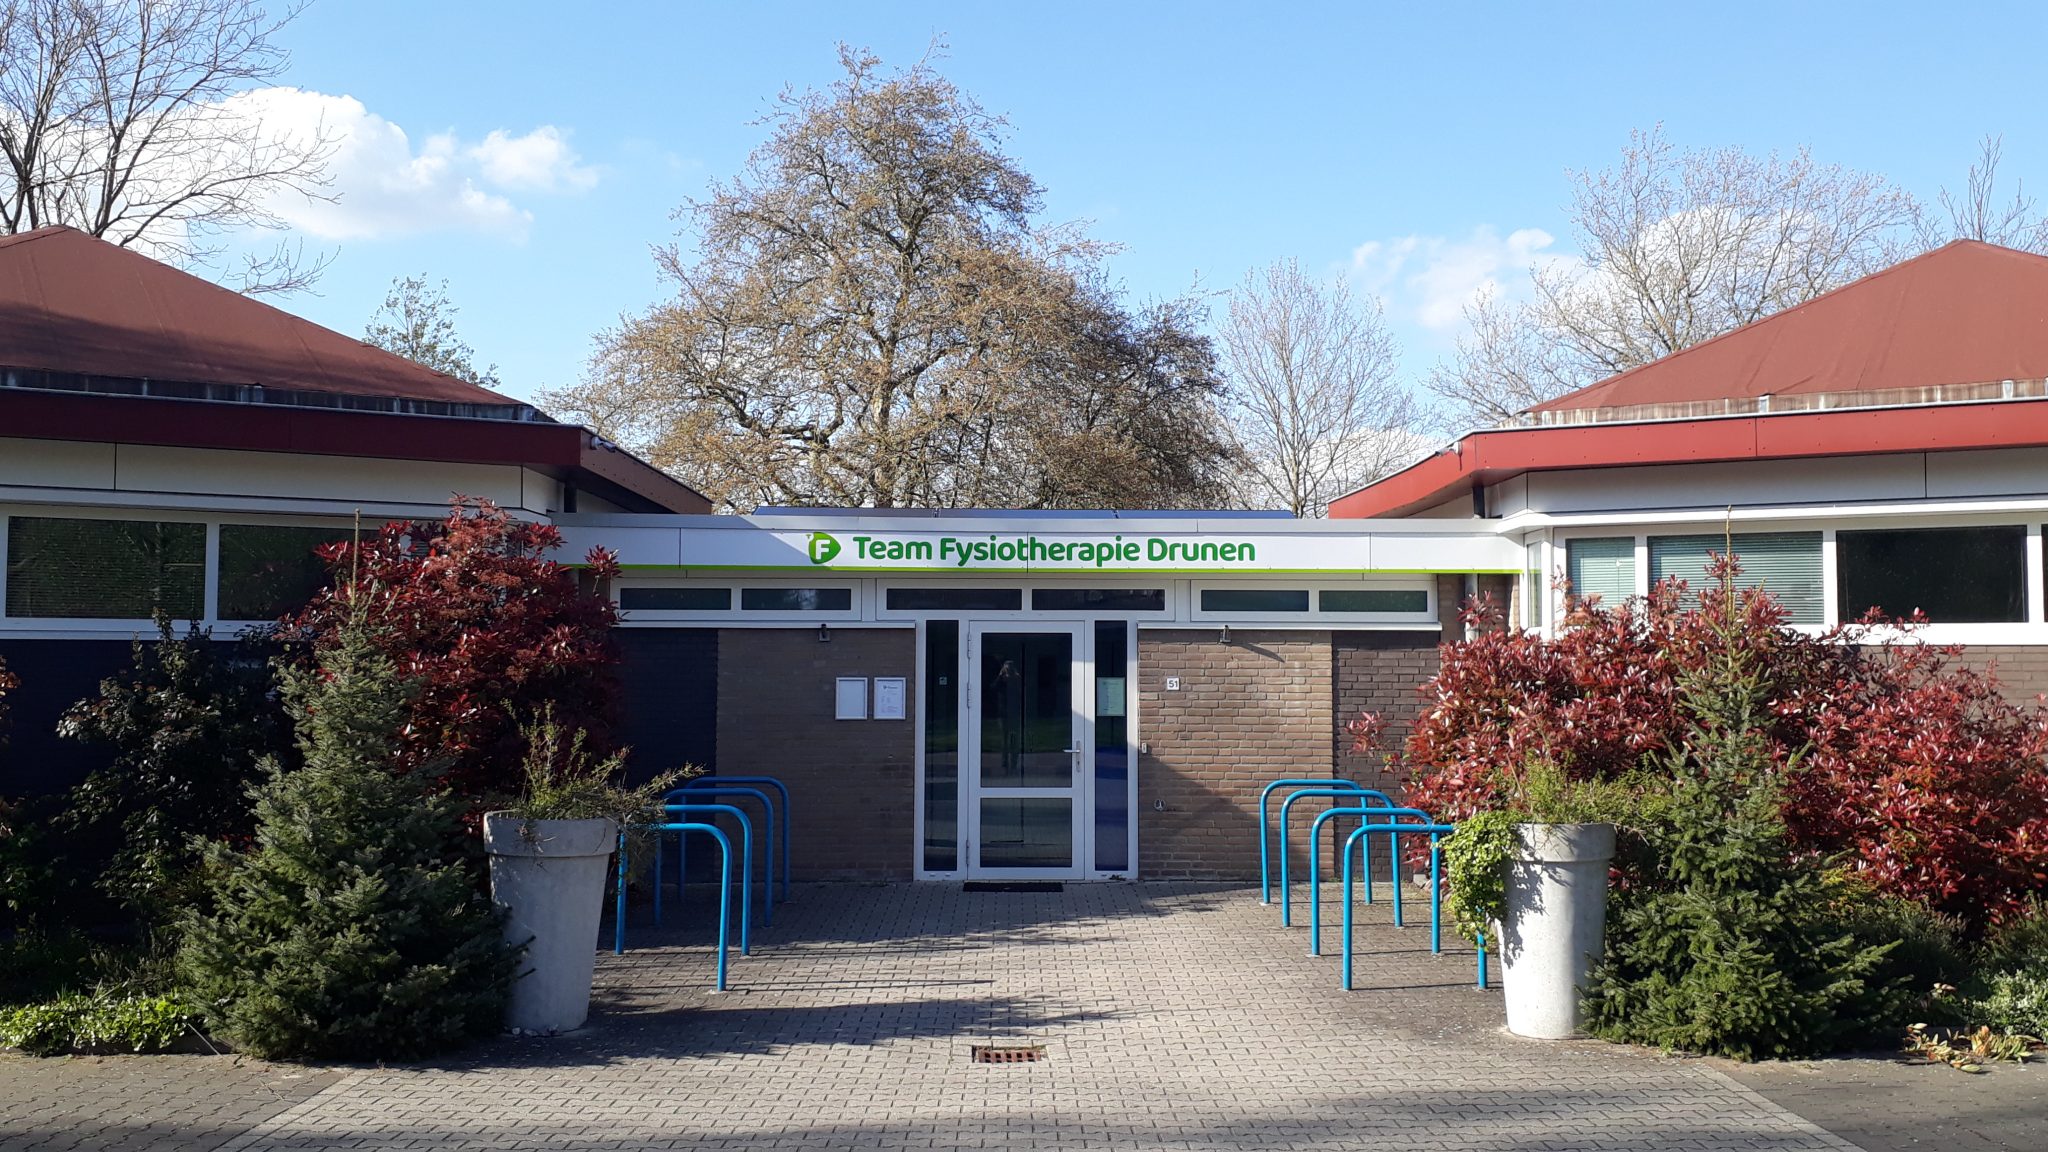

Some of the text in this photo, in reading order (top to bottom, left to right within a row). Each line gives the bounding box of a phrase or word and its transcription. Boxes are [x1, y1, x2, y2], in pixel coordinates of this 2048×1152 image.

[815, 539, 831, 560] F
[853, 535, 1257, 568] Team Fysiotherapie Drunen
[1168, 680, 1178, 688] 51
